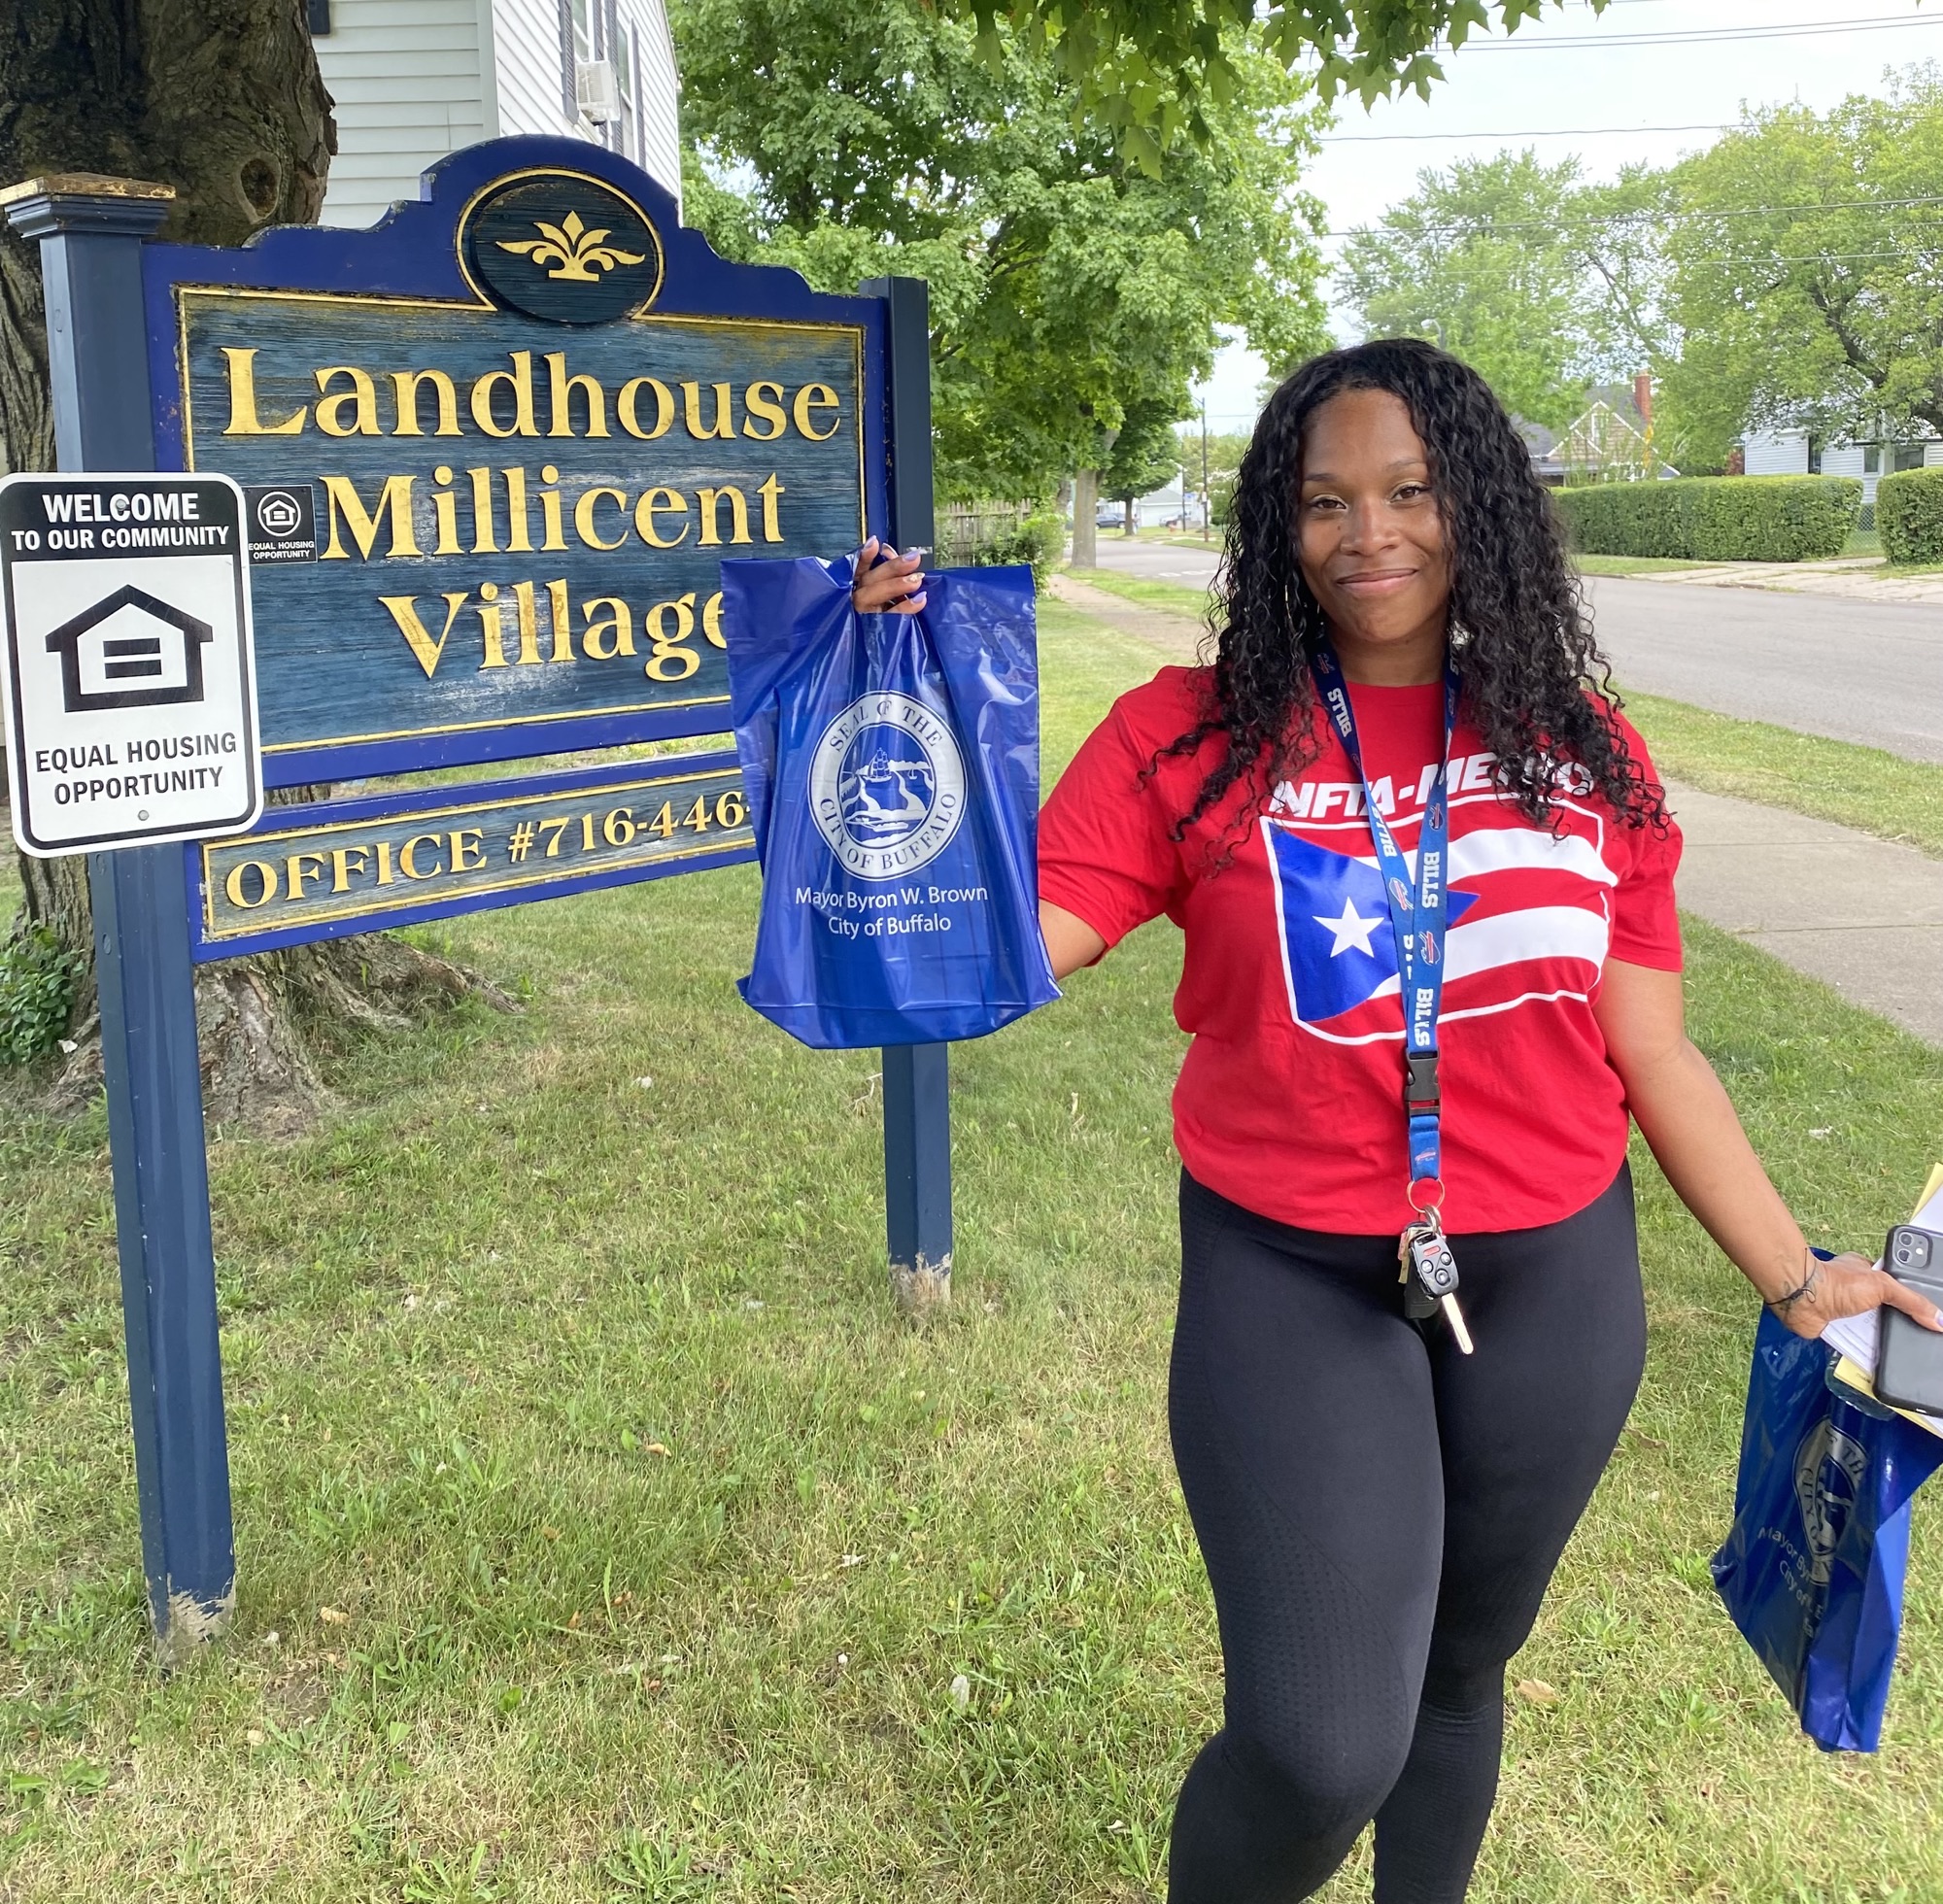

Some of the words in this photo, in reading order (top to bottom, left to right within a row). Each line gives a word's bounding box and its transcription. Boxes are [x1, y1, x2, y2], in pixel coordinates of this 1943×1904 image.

[221, 347, 841, 441] Landhouse
[42, 493, 200, 524] WELCOME
[319, 464, 786, 562] Millicent
[11, 530, 40, 551] TO
[48, 528, 94, 550] OUR
[101, 526, 229, 548] COMMUNITY
[248, 542, 276, 551] EQUAL
[278, 540, 315, 550] HOUSING
[253, 550, 310, 560] OPPORTUNITY
[830, 705, 869, 752] SEAL
[902, 705, 942, 747] THE
[1327, 688, 1352, 737] BILLS
[36, 743, 119, 772] EQUAL
[127, 731, 237, 764] HOUSING
[54, 765, 223, 805] OPPORTUNITY
[820, 798, 847, 848] CITY
[847, 847, 873, 868] OF
[881, 793, 956, 869] BUFFALO
[225, 828, 488, 908] OFFICE
[1421, 851, 1441, 908] BILLS
[796, 887, 843, 910] Mayor
[847, 890, 897, 913] Byron
[900, 888, 924, 904] W.
[928, 885, 988, 903] Brown
[828, 916, 860, 939] City
[864, 917, 883, 936] of
[887, 912, 952, 935] Buffalo
[1415, 987, 1435, 1046] BILLS
